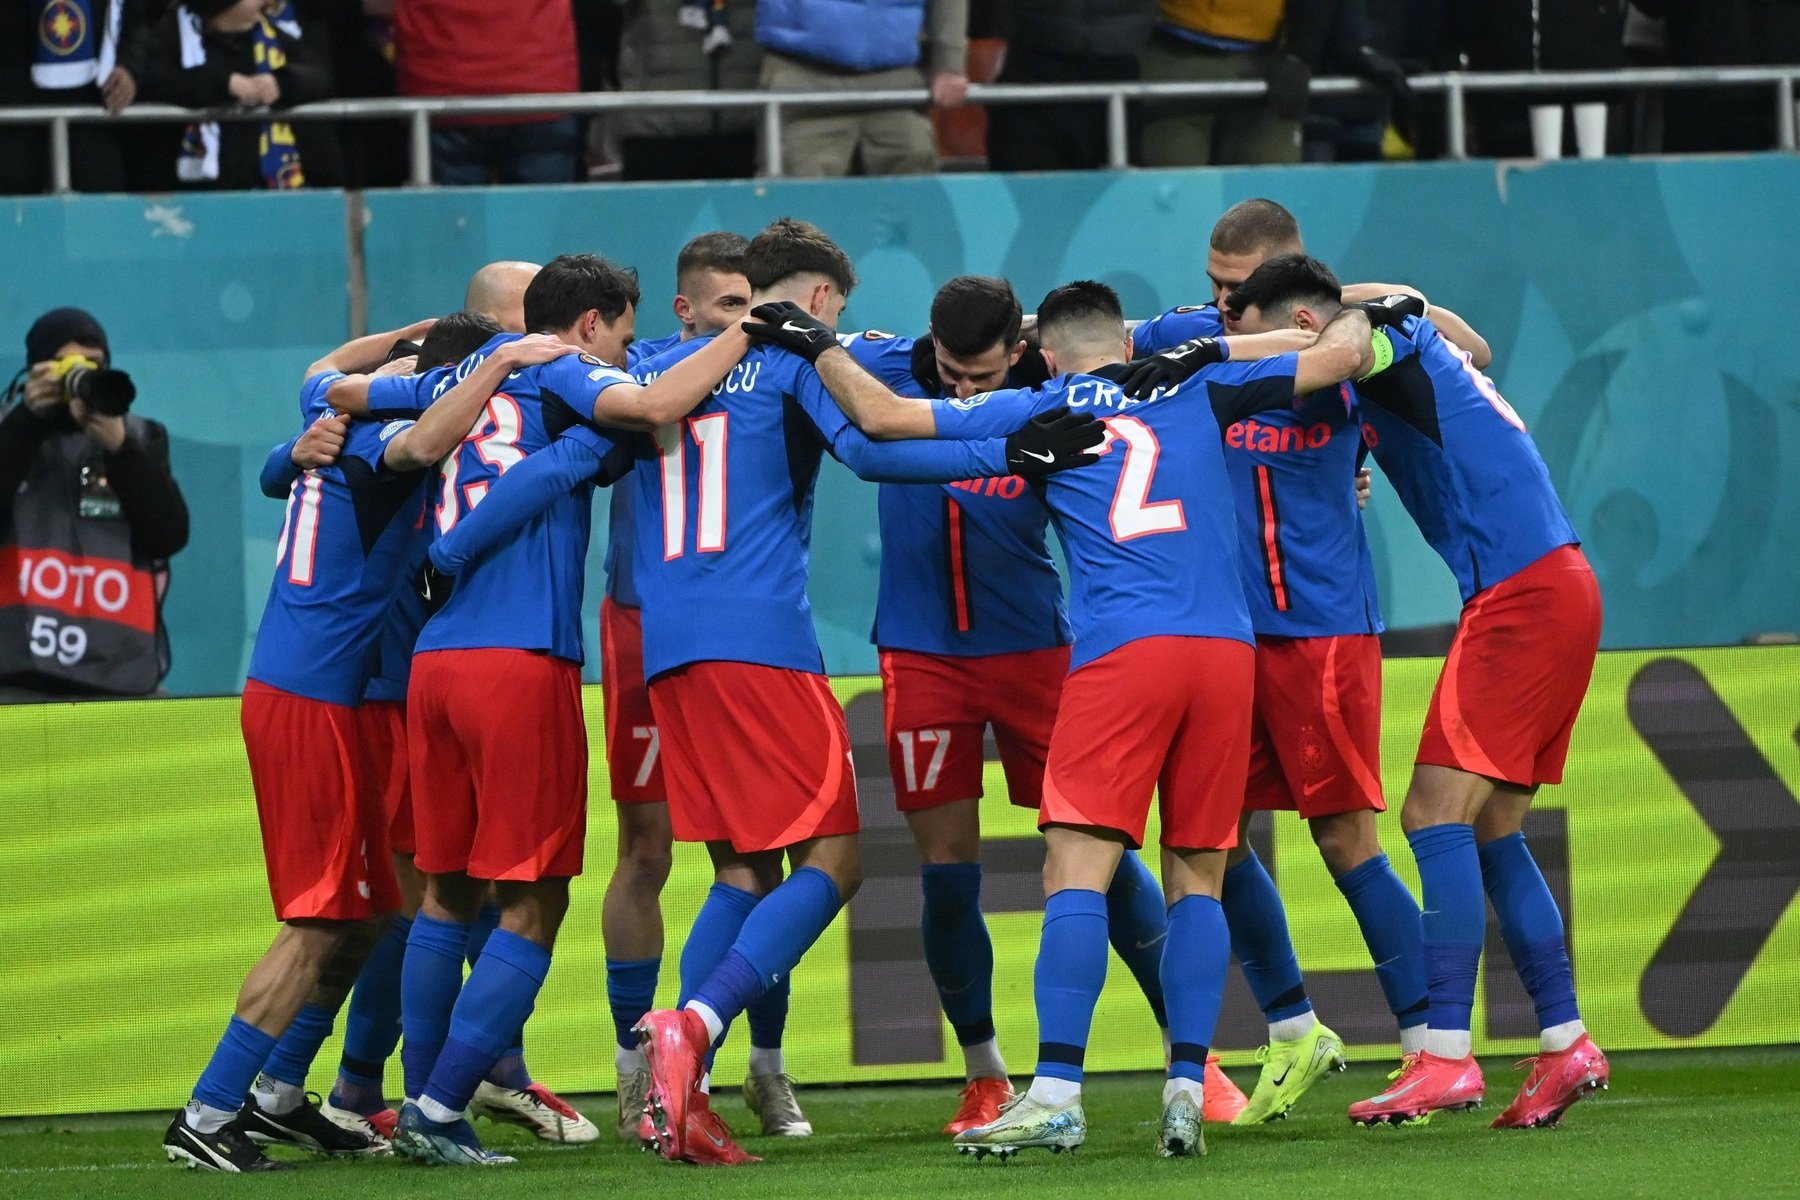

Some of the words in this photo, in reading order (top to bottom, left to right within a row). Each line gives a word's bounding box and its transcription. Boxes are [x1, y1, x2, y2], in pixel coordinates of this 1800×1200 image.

[1225, 418, 1332, 454] etano
[652, 411, 729, 562] 11
[1078, 414, 1188, 543] 2
[29, 614, 88, 667] 59
[632, 726, 660, 788] 7
[896, 729, 951, 793] 17
